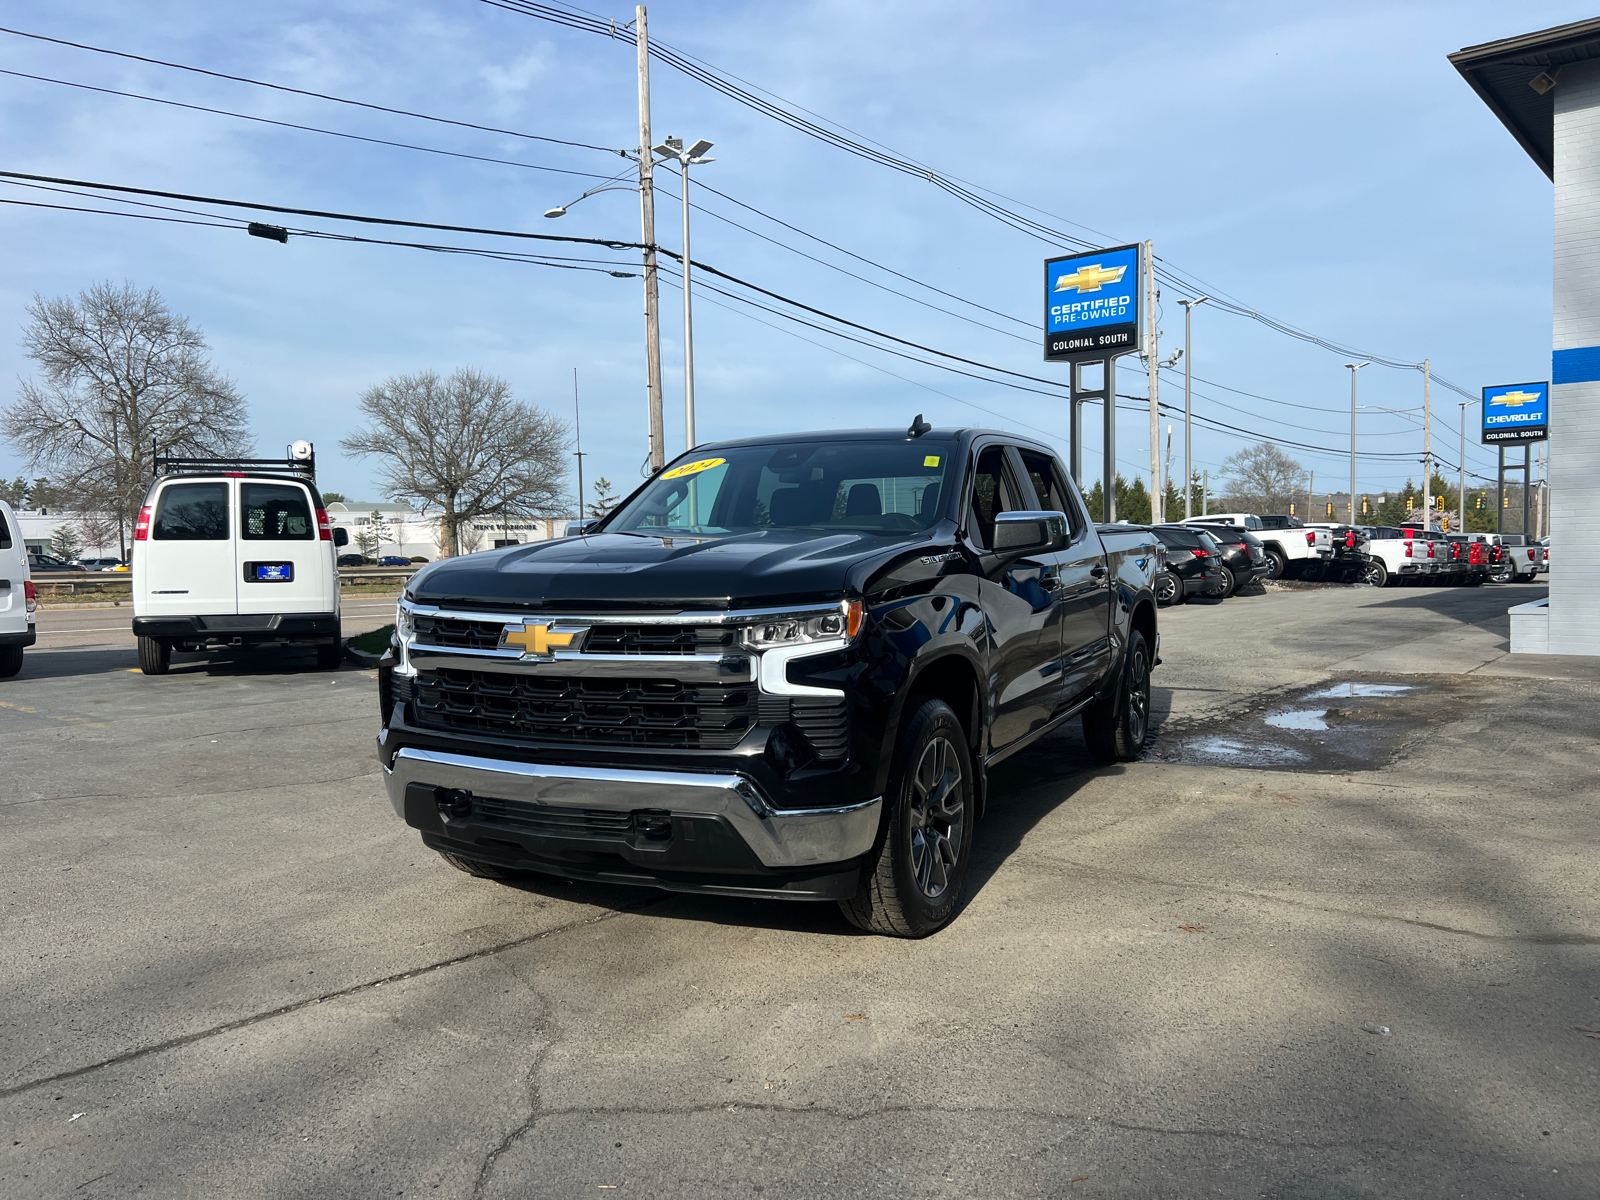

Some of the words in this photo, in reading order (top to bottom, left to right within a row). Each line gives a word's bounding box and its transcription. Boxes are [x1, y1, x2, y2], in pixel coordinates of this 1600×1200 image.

[1051, 295, 1130, 315] CERTIFIED
[1055, 306, 1126, 324] PRE-OWNED
[1053, 338, 1094, 350] COLONIAL
[1099, 333, 1128, 345] SOUTH
[1487, 412, 1543, 423] CHEVROLET
[668, 459, 718, 478] 2024
